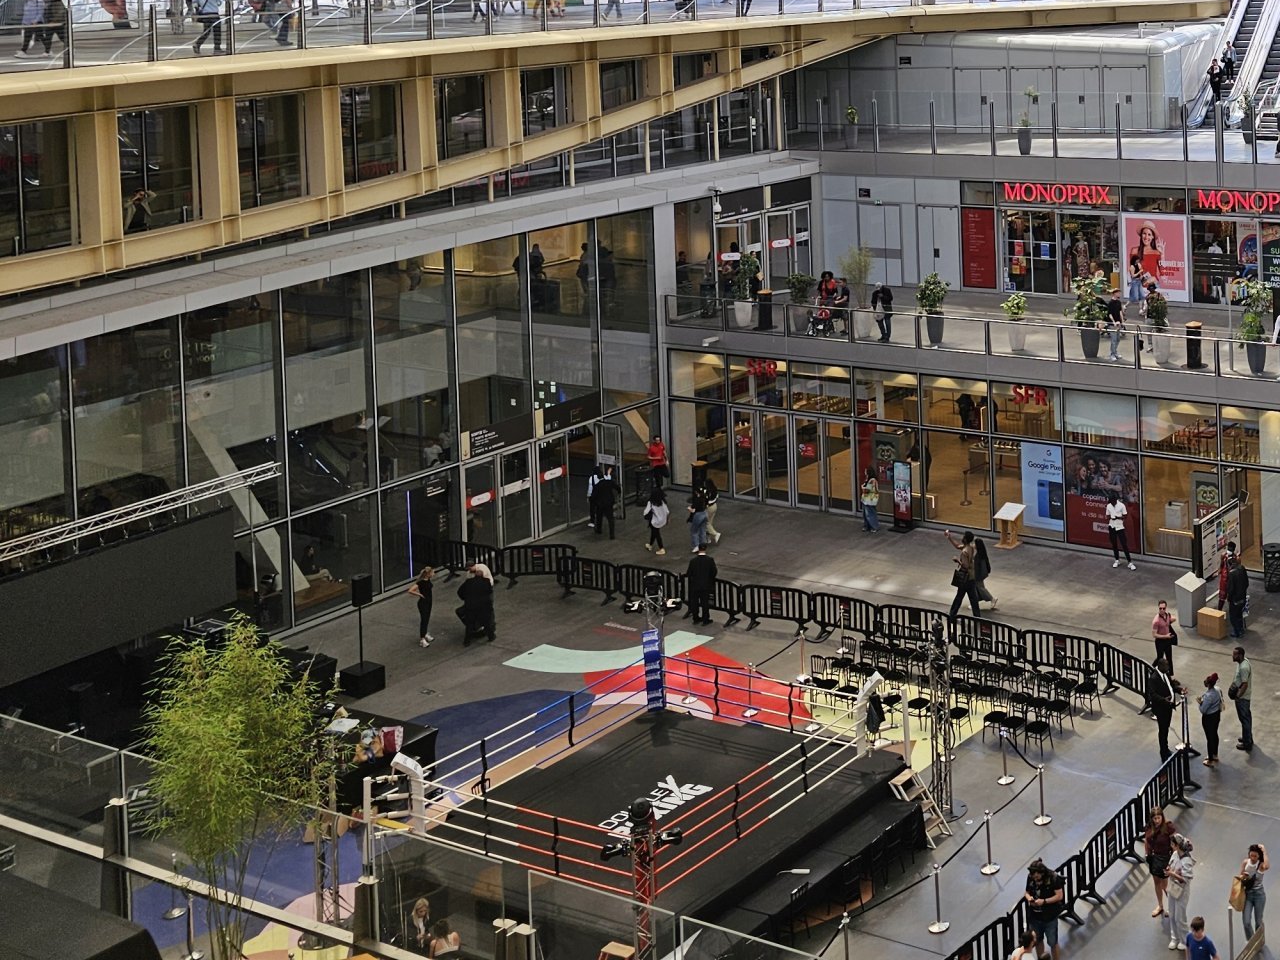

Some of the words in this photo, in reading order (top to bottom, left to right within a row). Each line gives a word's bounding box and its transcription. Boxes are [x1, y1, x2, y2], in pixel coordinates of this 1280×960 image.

[1003, 182, 1112, 205] MONOPRIX
[745, 358, 778, 377] SFR
[1011, 384, 1048, 406] SFR
[1028, 460, 1049, 470] Google
[1049, 463, 1062, 471] Pixe
